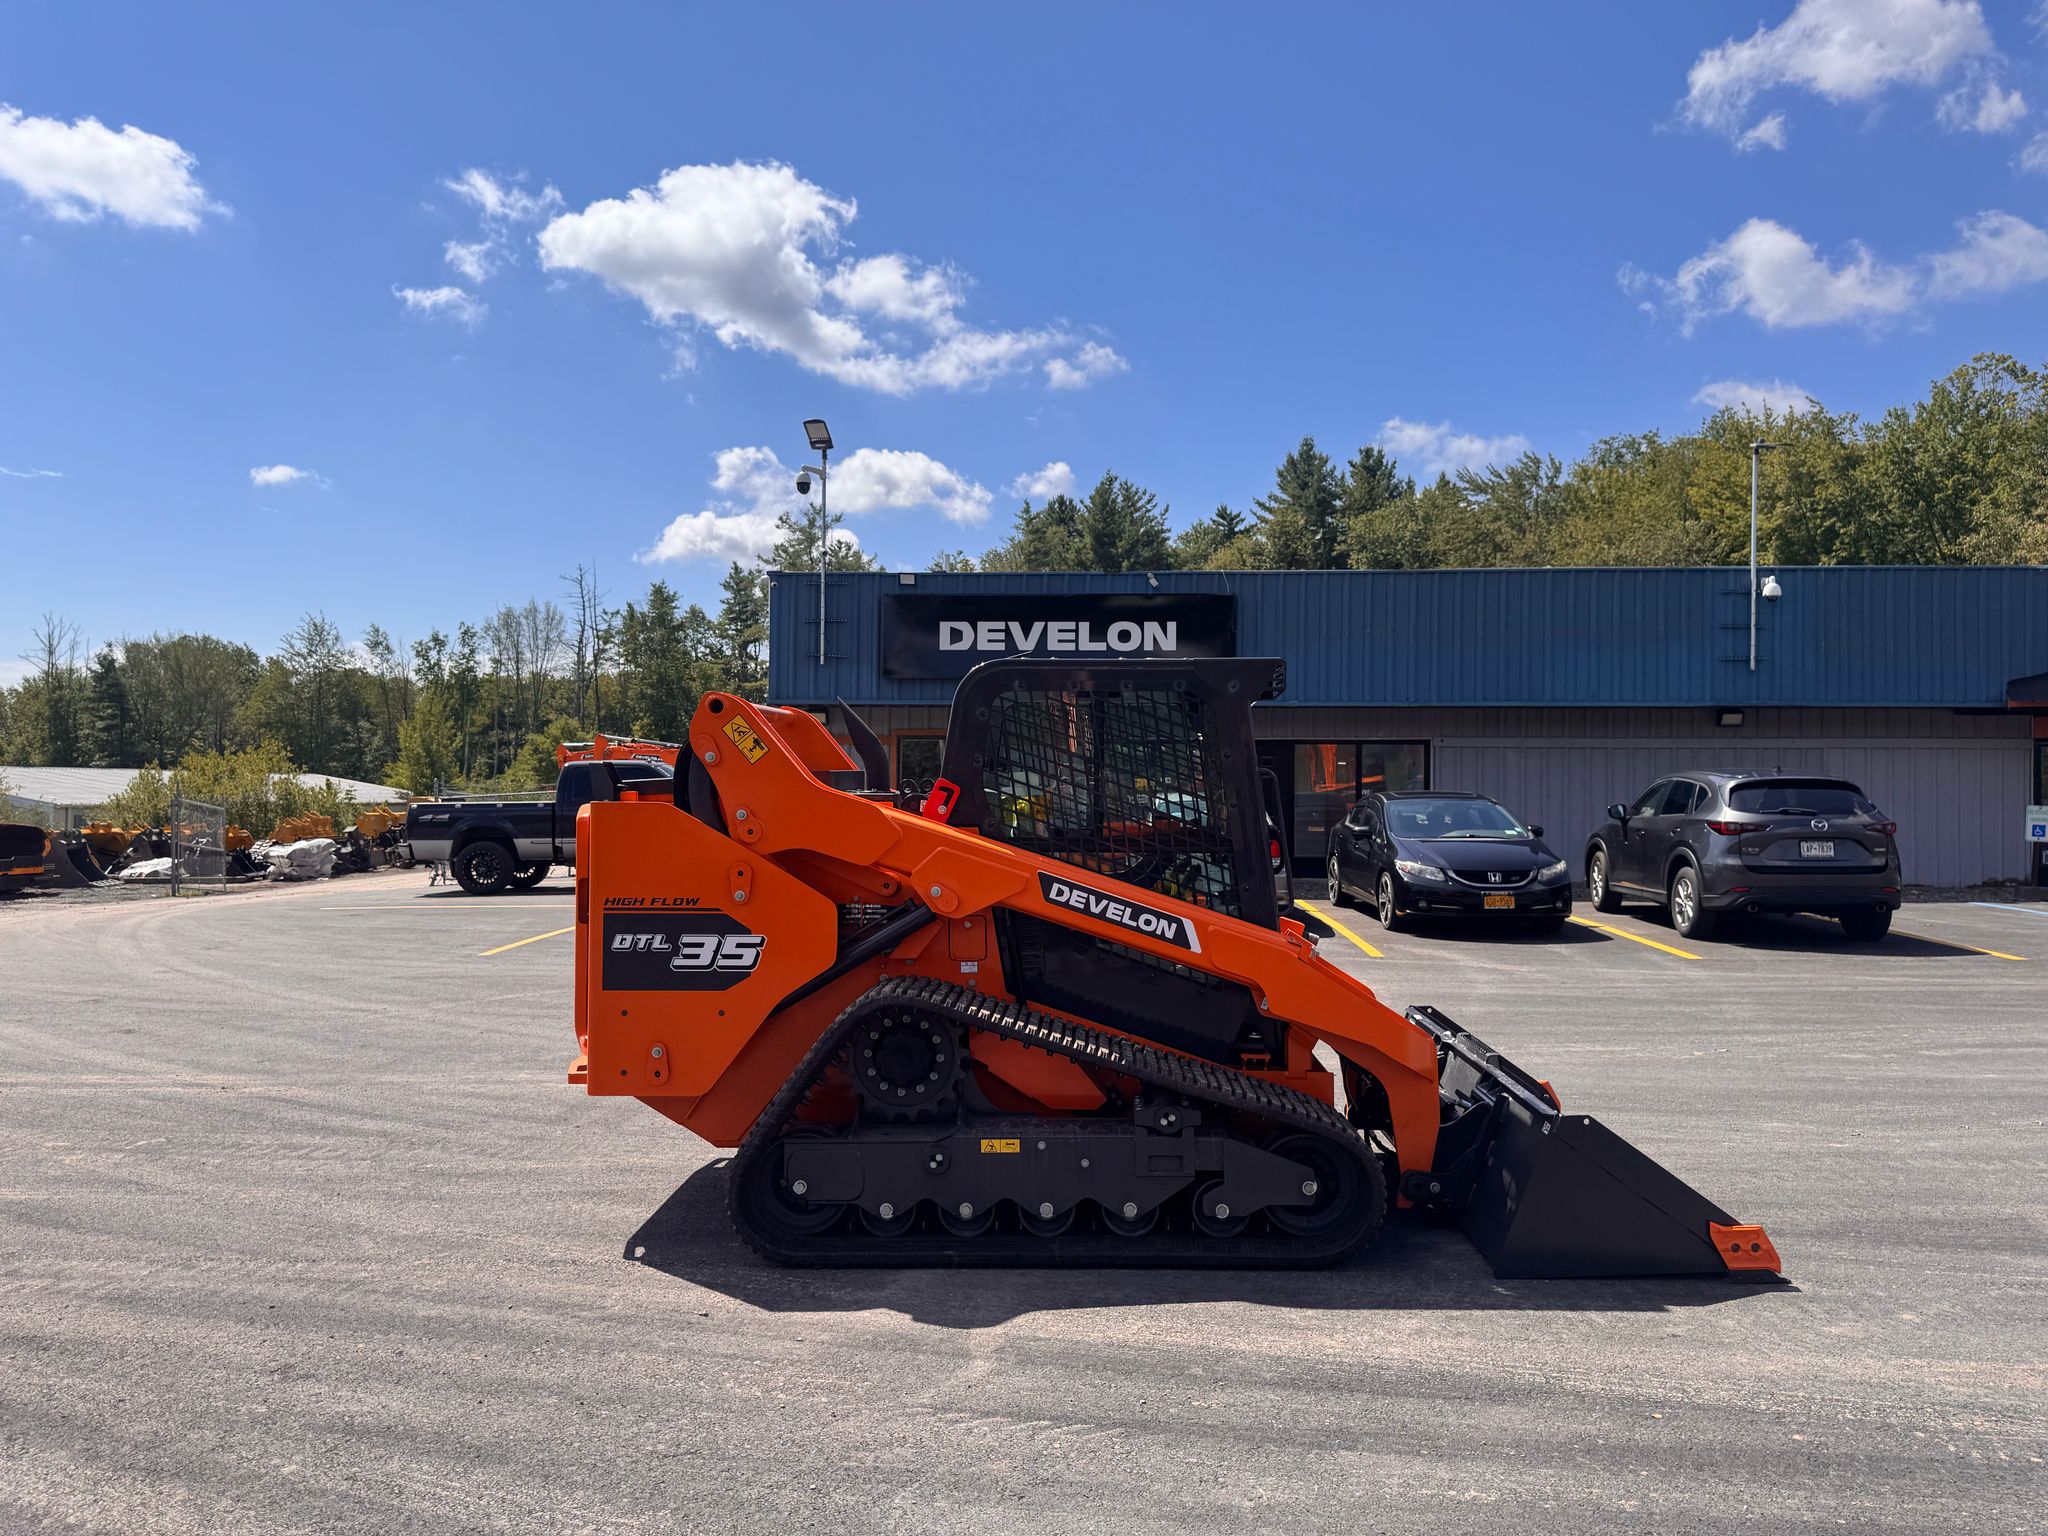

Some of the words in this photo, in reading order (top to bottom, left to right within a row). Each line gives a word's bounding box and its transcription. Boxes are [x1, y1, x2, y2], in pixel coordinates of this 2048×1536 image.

[939, 621, 1177, 651] DEVELON
[603, 897, 644, 906] HIGH
[650, 897, 700, 906] FLOW
[1049, 882, 1178, 940] DEVELON
[611, 933, 673, 952] DTL
[670, 933, 768, 972] 35
